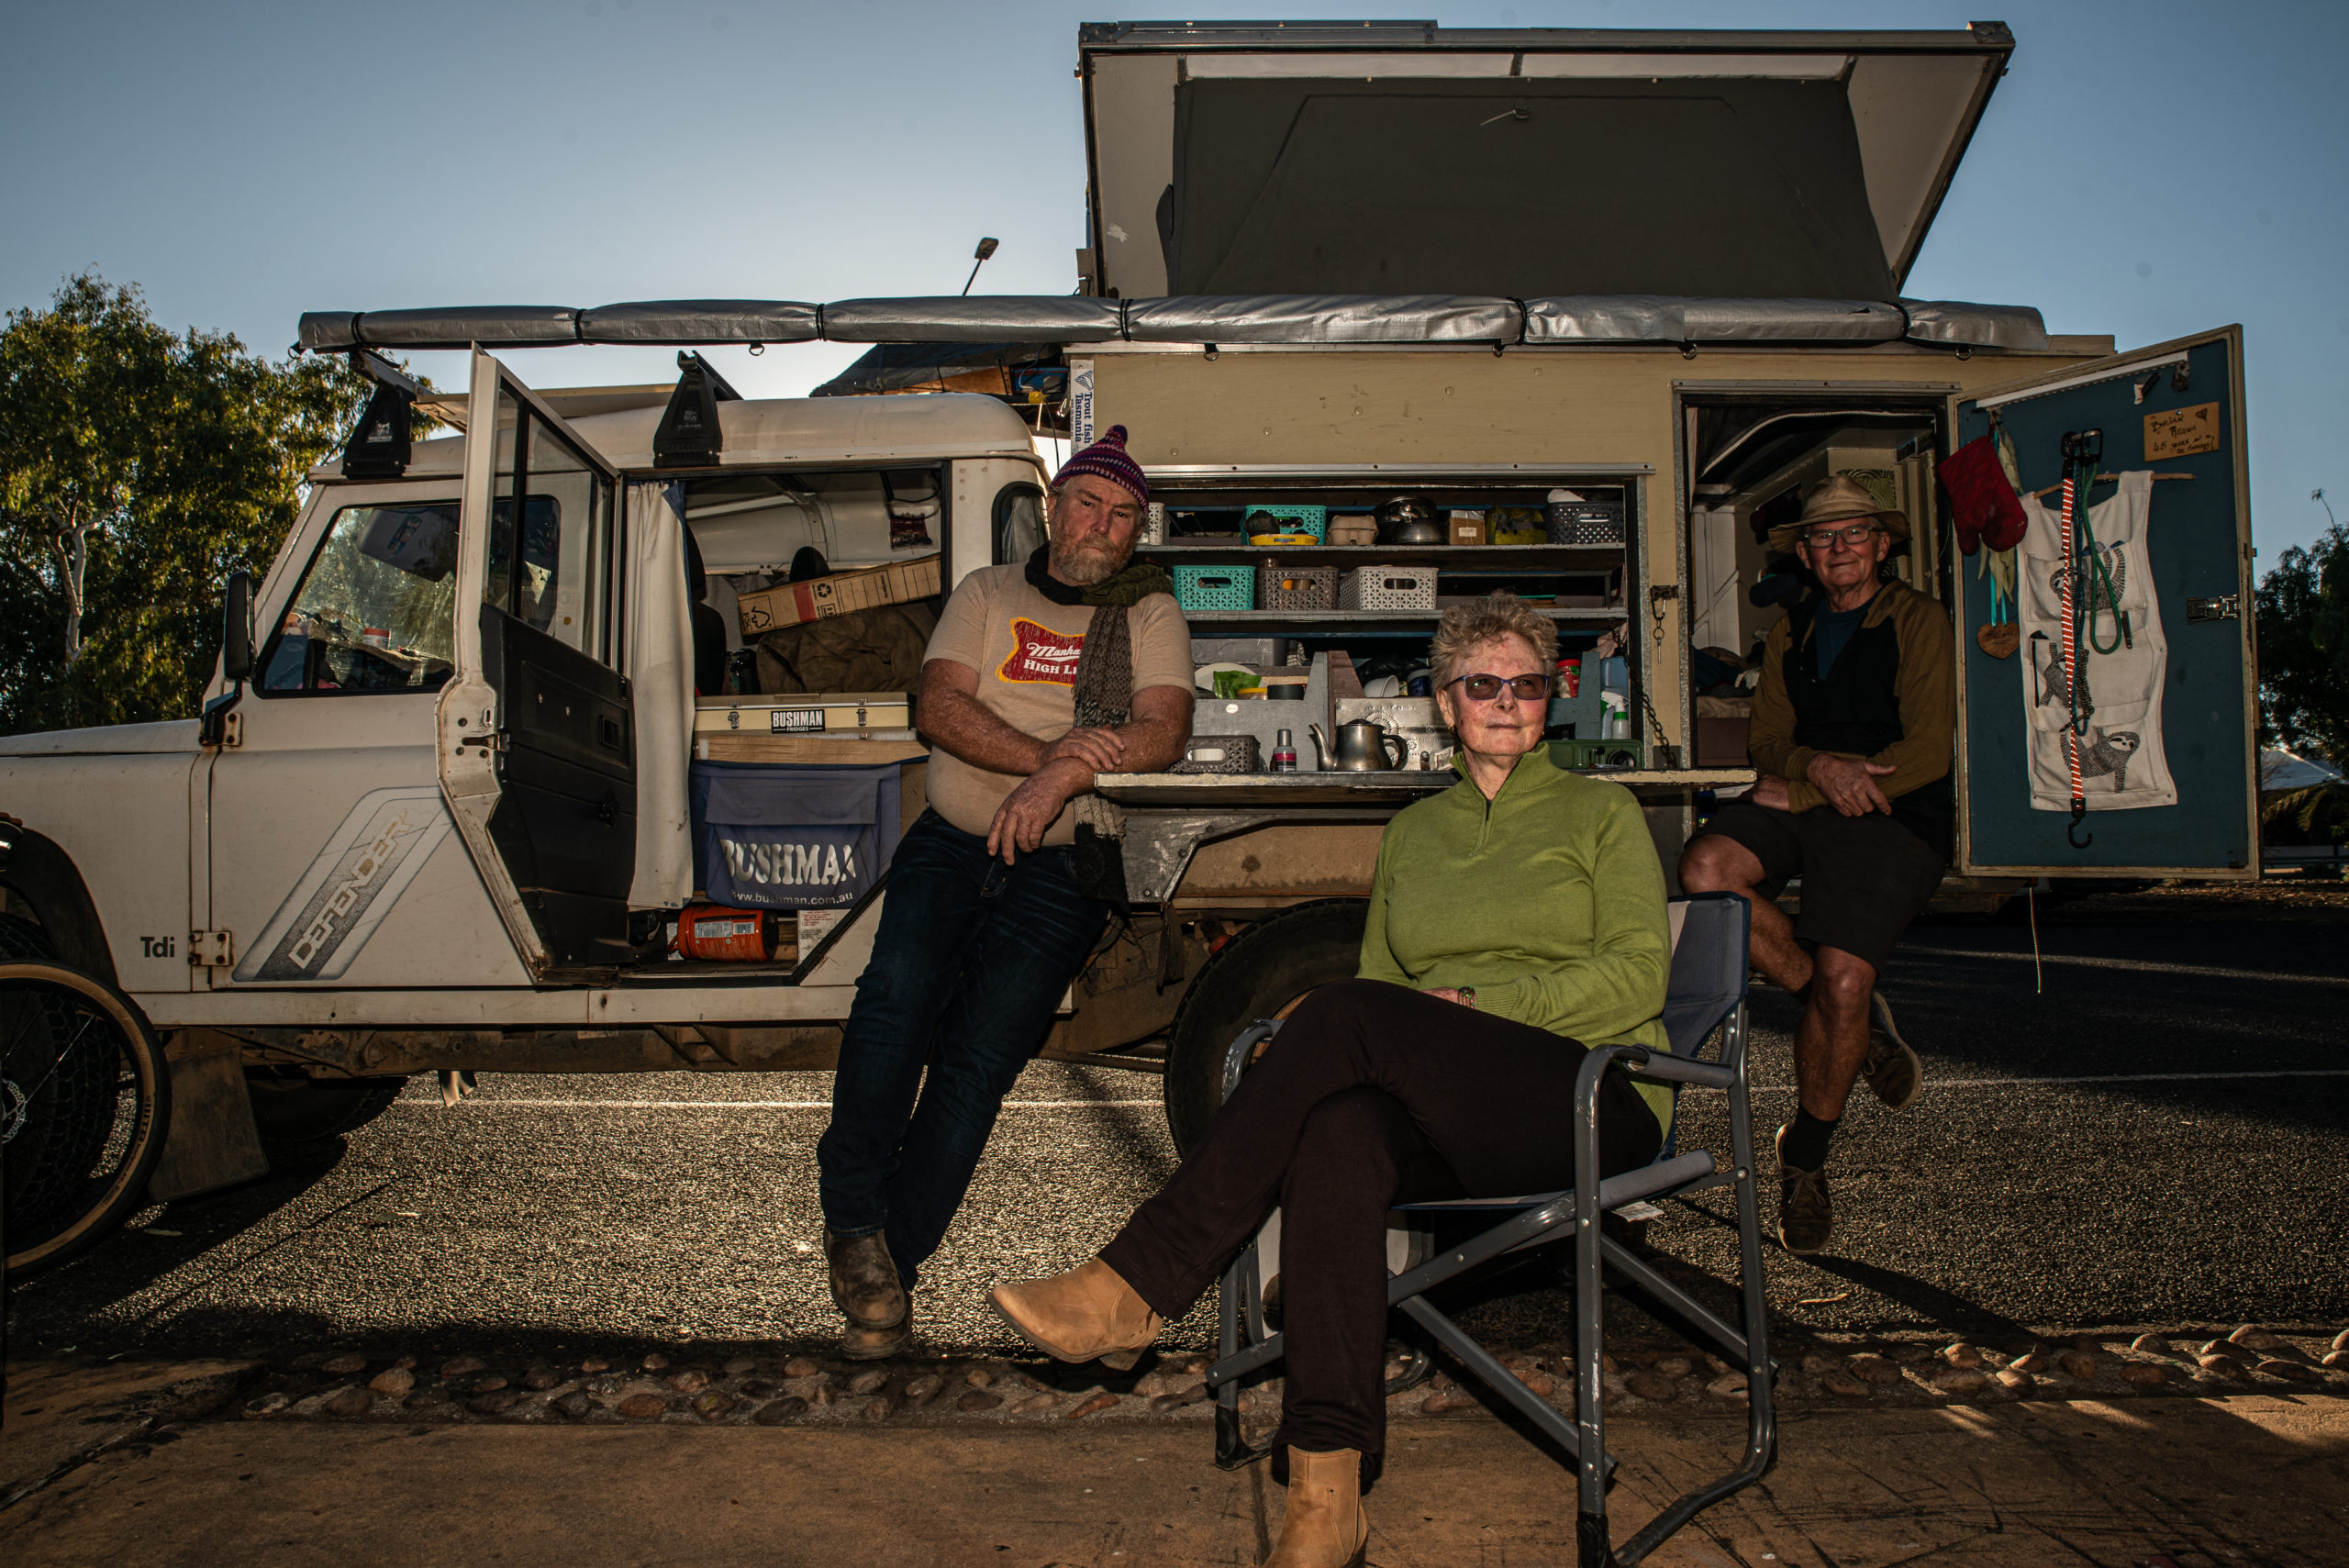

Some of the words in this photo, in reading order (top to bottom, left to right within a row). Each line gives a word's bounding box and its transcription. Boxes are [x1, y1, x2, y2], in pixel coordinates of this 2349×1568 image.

[1074, 393, 1084, 442] Tasmania
[1084, 392, 1093, 419] Trout
[1084, 424, 1093, 443] fish
[773, 710, 823, 727] BUSHMAN
[288, 808, 413, 970] DEFENDER
[139, 936, 175, 958] Tdi
